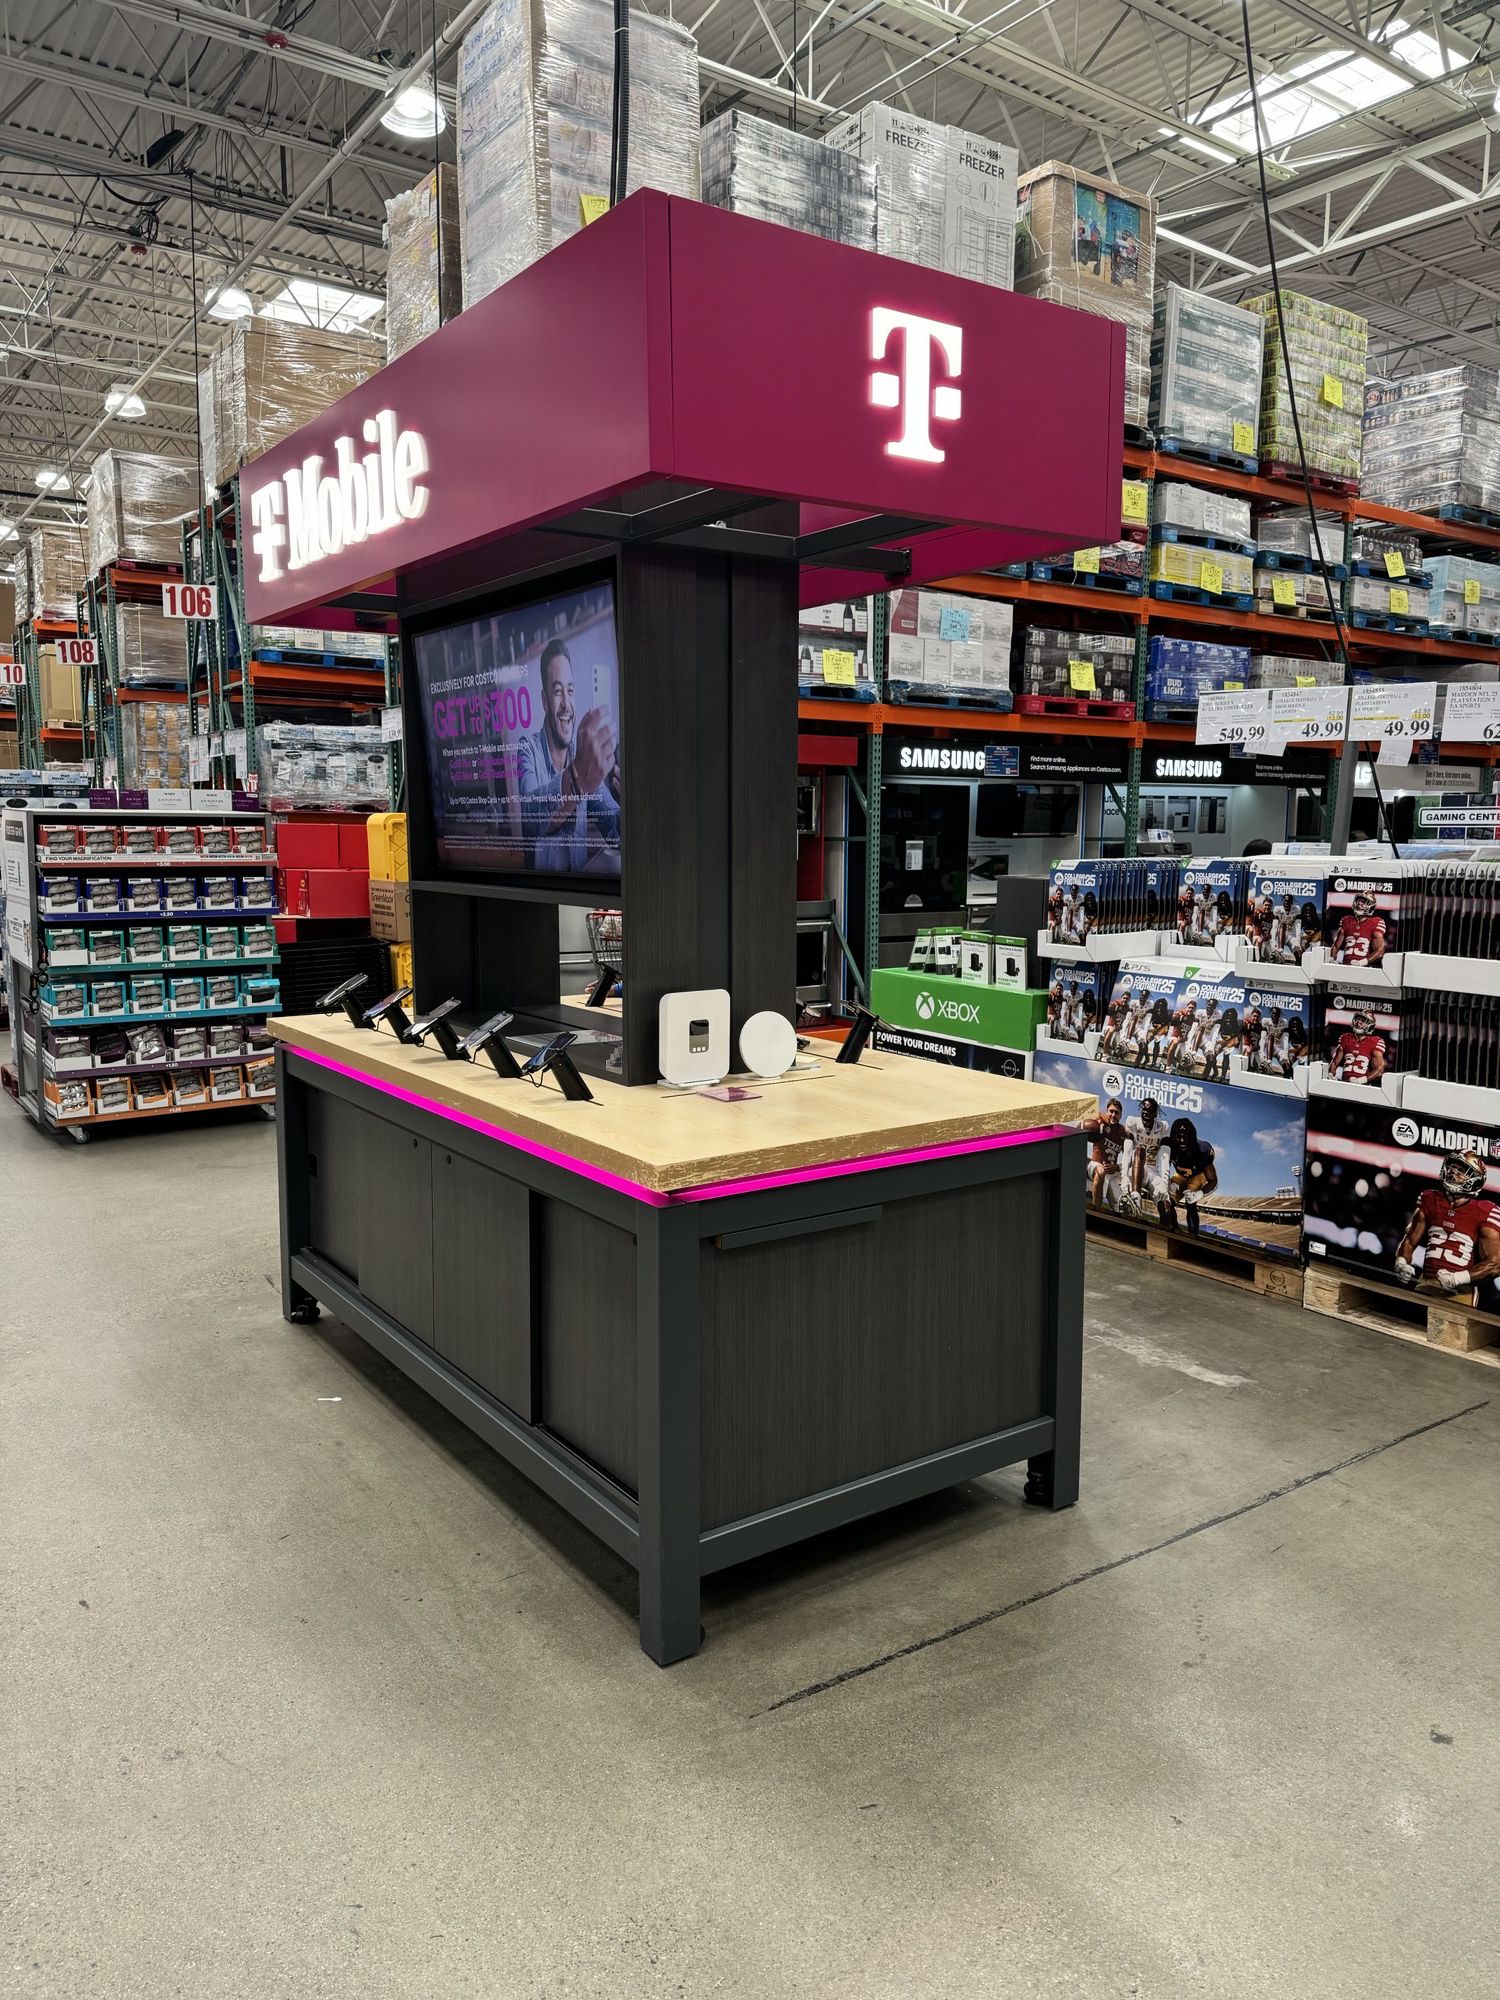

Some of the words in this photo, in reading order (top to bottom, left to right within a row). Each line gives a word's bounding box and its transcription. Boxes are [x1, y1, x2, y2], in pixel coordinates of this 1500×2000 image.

[960, 152, 1005, 180] FREEZER
[870, 306, 963, 464] T
[166, 586, 212, 616] 106
[58, 640, 94, 664] 108
[430, 678, 463, 694] EXCLUSIVELY
[464, 676, 474, 688] FOR
[475, 670, 498, 685] COSTCO
[1163, 686, 1185, 695] LIGHT
[1167, 679, 1182, 687] BUD
[469, 694, 480, 714] UP
[433, 696, 467, 738] GET
[472, 717, 484, 735] TO
[1219, 726, 1265, 742] 549.99
[1302, 722, 1343, 737] 49.99
[1384, 720, 1430, 736] 49.99
[478, 743, 496, 753] T-Mobile
[900, 747, 986, 771] SAMSUNG
[1156, 758, 1222, 778] SAMSUNG
[1148, 873, 1157, 885] 25
[1347, 880, 1375, 892] MADDEN
[1383, 883, 1392, 892] 25
[1302, 883, 1316, 896] 25
[1344, 936, 1370, 956] 23
[1132, 982, 1160, 990] FOOTBALL
[1134, 976, 1161, 985] COLLEGE
[1160, 980, 1176, 994] 25
[1200, 984, 1230, 994] COLLEGE
[1229, 988, 1245, 1003] 25
[1199, 990, 1229, 1000] FOOTBALL
[1262, 994, 1289, 1002] COLLEGE
[1289, 997, 1303, 1010] 25
[938, 1000, 980, 1024] XBOX
[1346, 999, 1375, 1010] MADDEN
[1382, 1003, 1392, 1012] 25
[876, 1032, 902, 1045] POWER
[902, 1037, 923, 1049] YOUR
[924, 1042, 956, 1057] DREAMS
[1343, 1054, 1369, 1074] 23
[1107, 1075, 1120, 1085] EA
[1124, 1084, 1176, 1108] FOOTBALL
[1126, 1074, 1177, 1092] COLLEGE
[1176, 1084, 1203, 1114] 25
[1397, 1123, 1414, 1134] EA
[1421, 1126, 1489, 1157] MADDEN
[1425, 1225, 1474, 1267] 23
